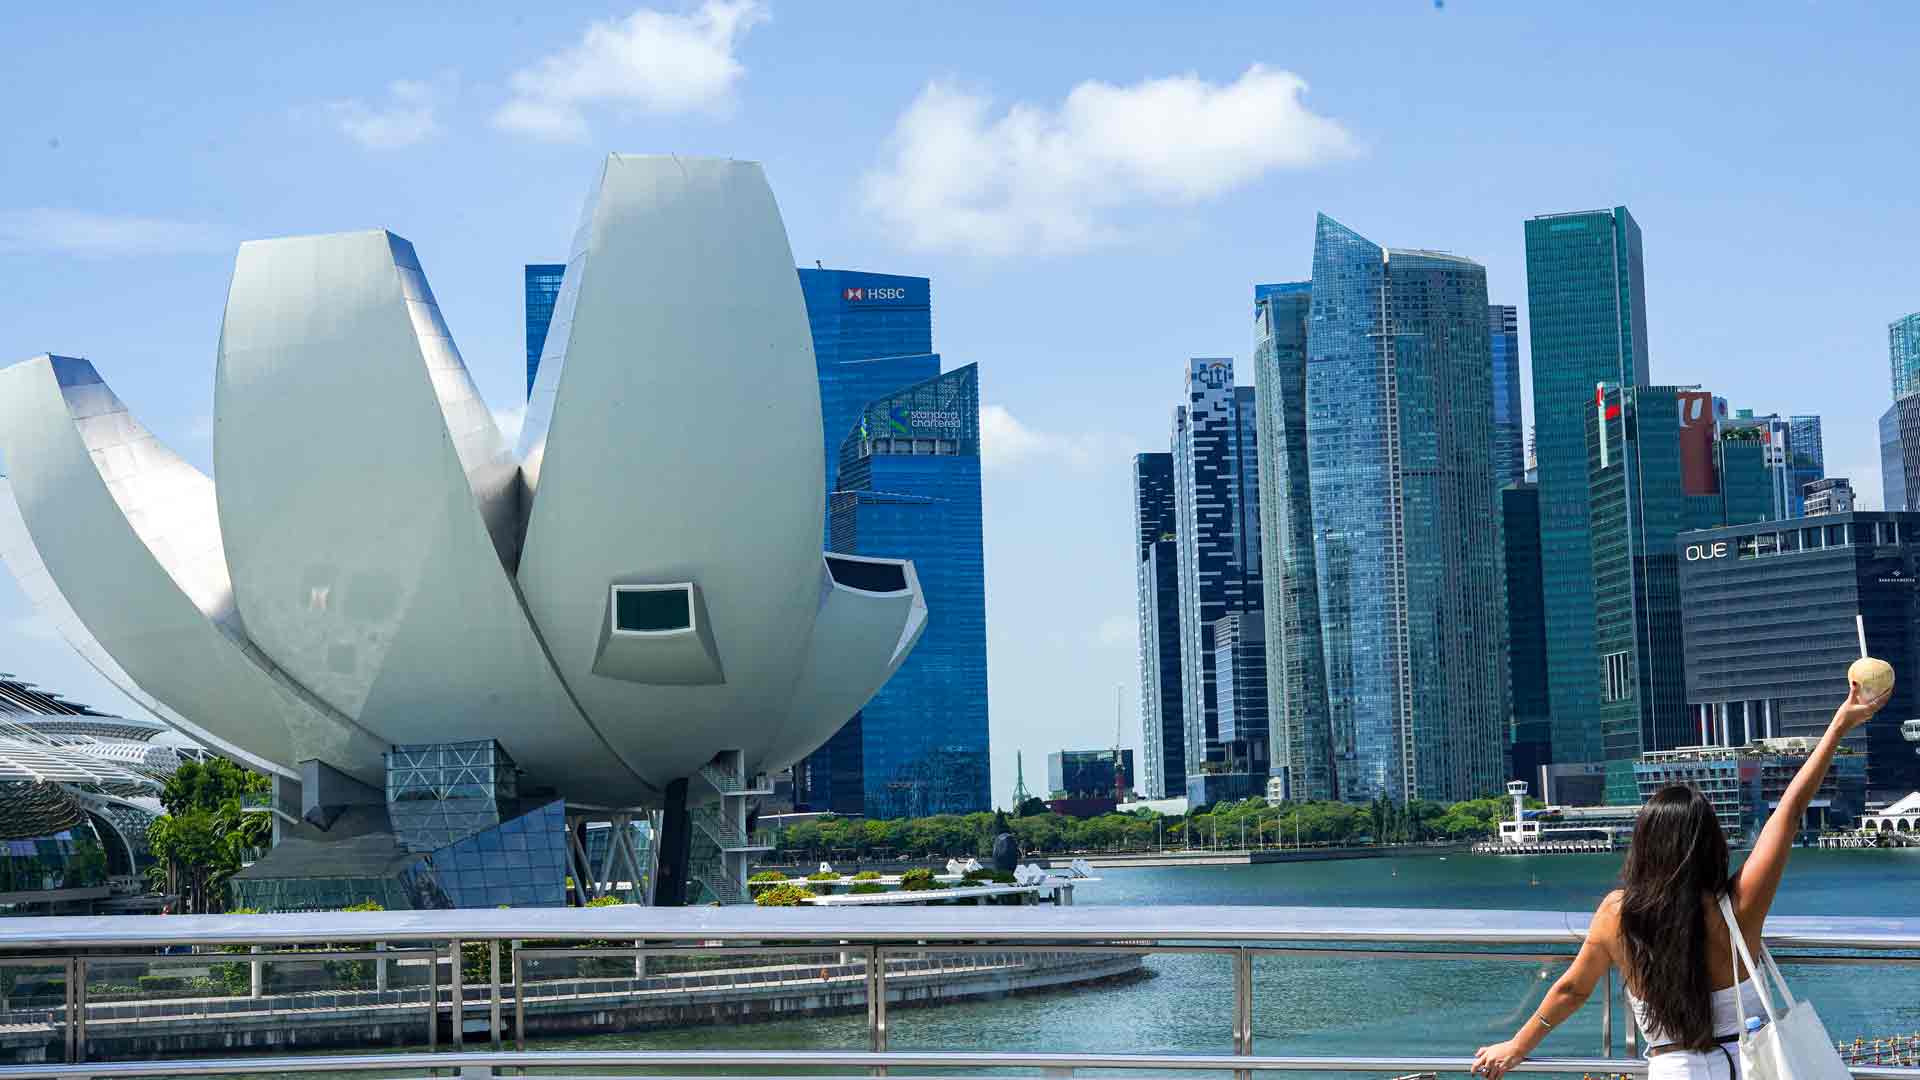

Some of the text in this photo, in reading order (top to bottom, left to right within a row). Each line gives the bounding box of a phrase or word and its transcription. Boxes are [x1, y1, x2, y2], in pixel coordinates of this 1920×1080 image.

[868, 288, 905, 300] HSBC
[1198, 367, 1228, 384] citi
[911, 409, 958, 419] standard
[911, 418, 961, 428] chartered
[1686, 542, 1728, 561] OUE
